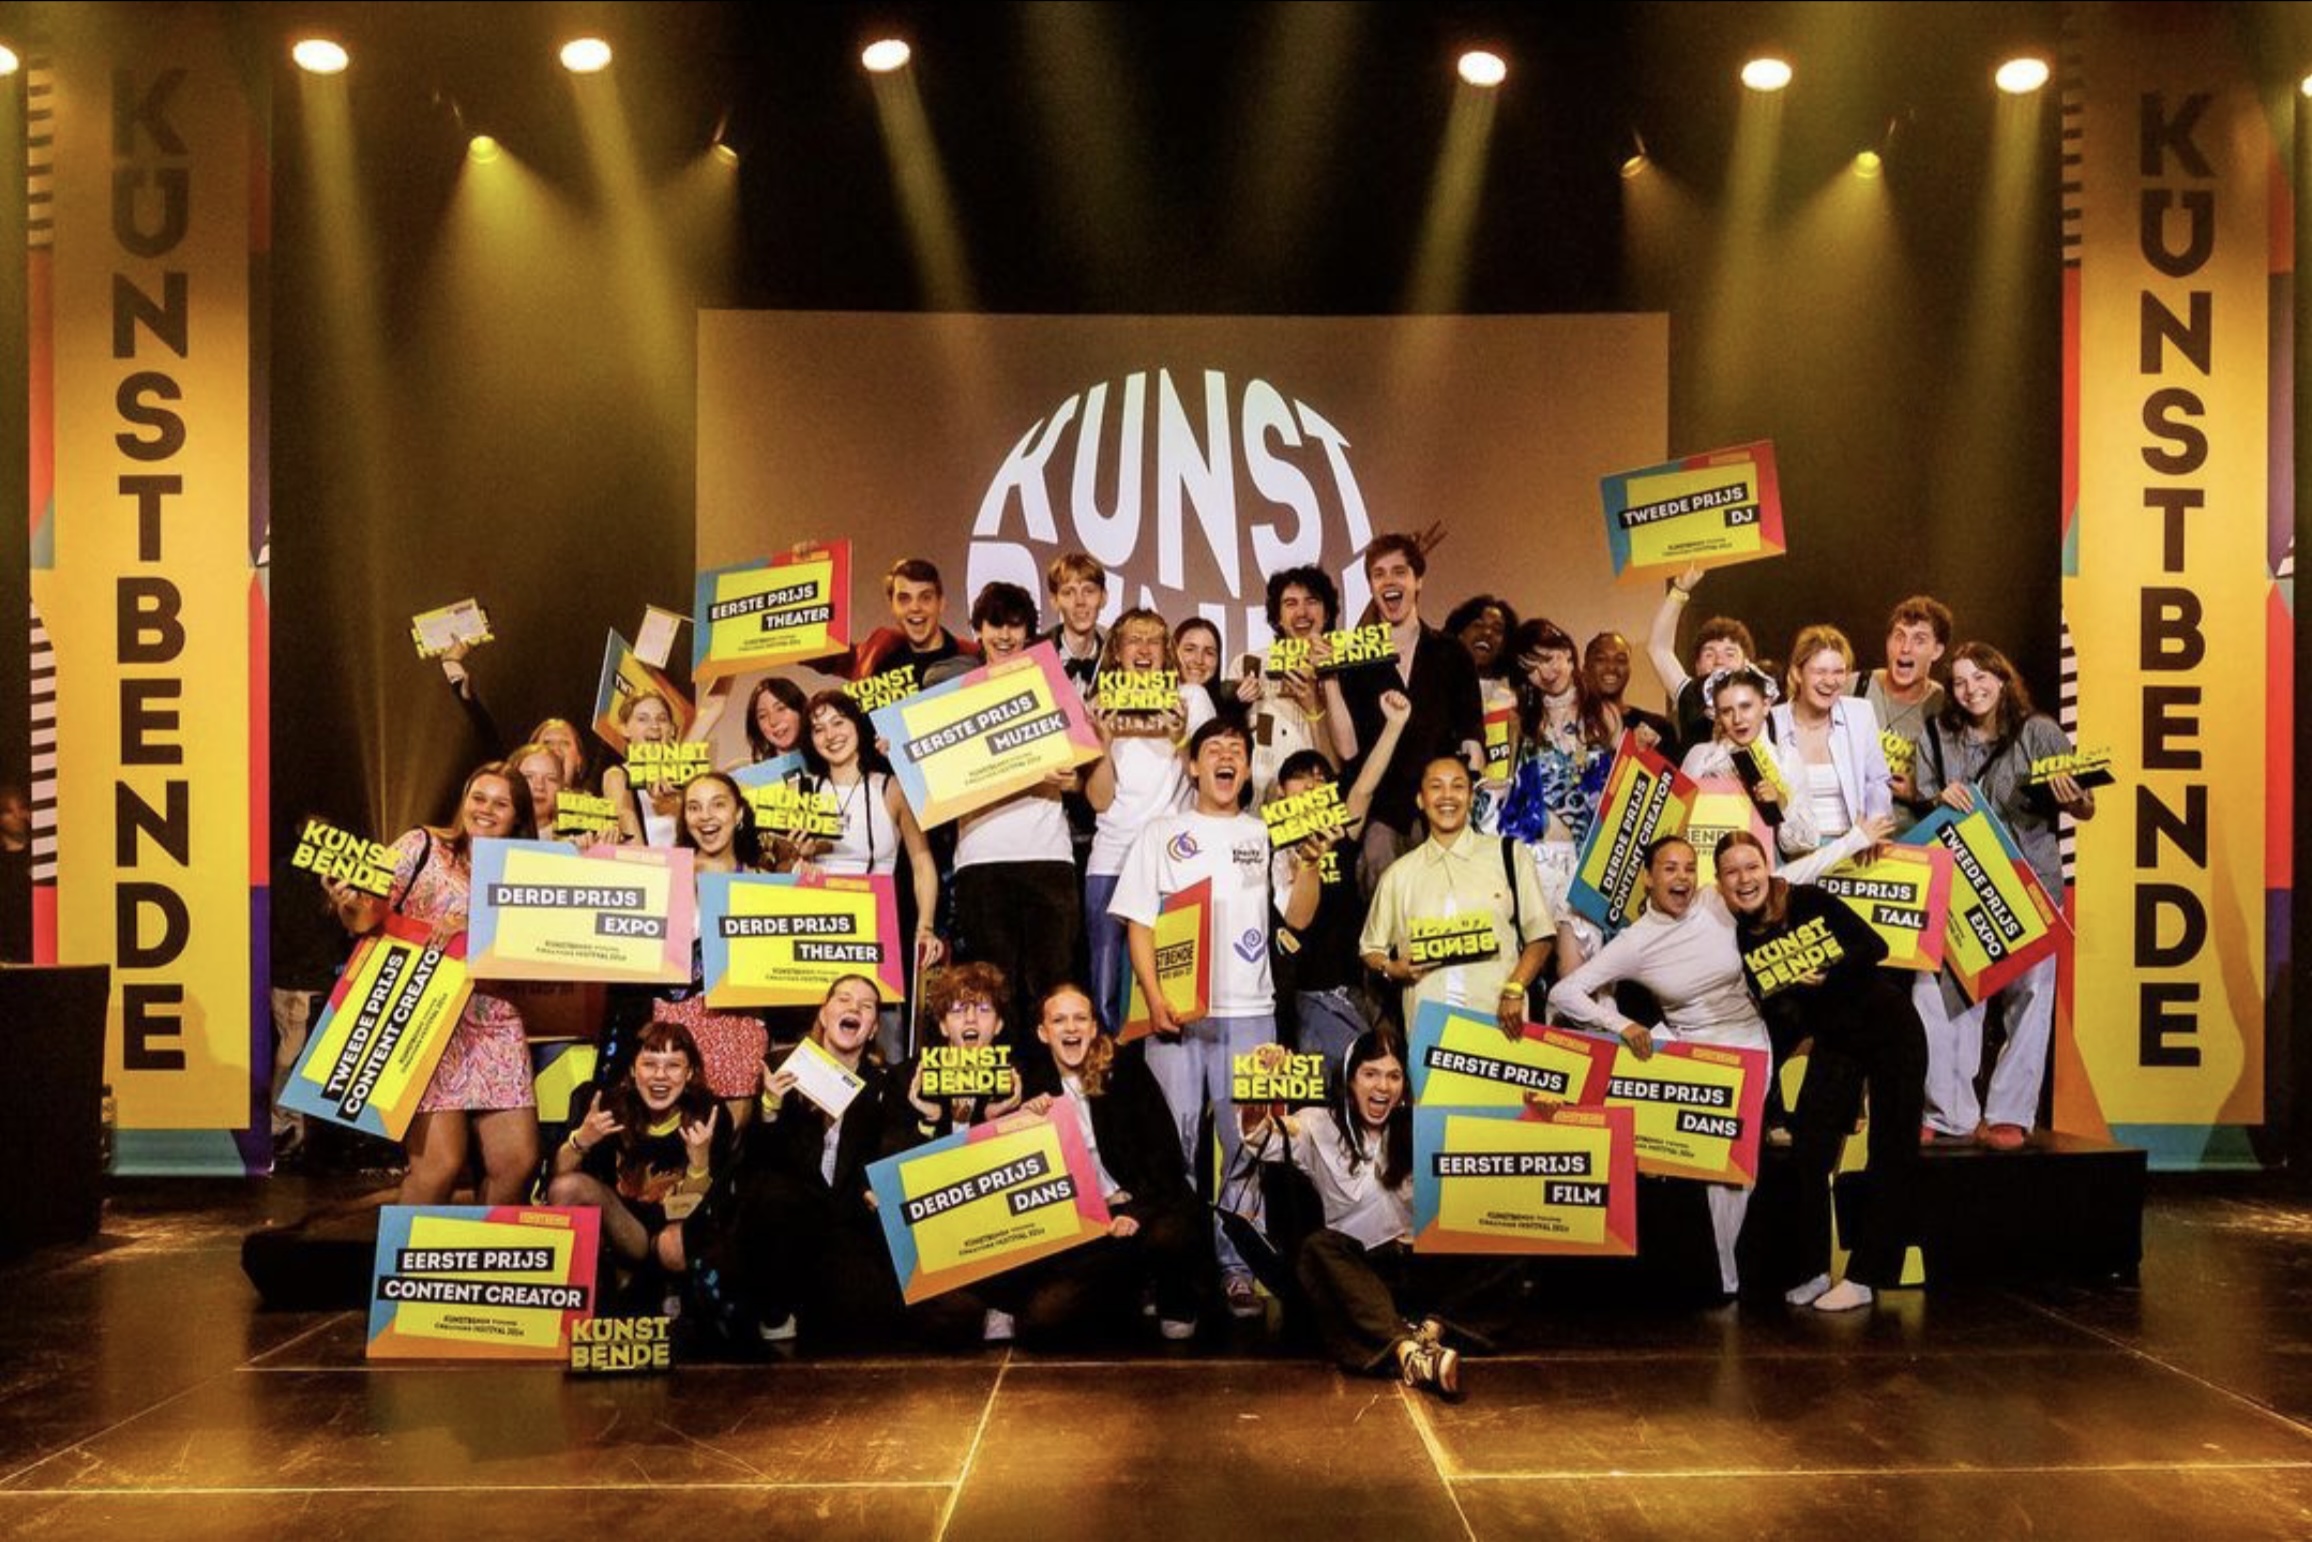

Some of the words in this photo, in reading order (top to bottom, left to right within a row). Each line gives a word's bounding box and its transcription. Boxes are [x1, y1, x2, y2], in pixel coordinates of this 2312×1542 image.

[971, 368, 1373, 598] KUNST
[1623, 499, 1690, 526] TWEEDE
[1692, 486, 1744, 510] PRIJS
[1731, 507, 1753, 525] DJ
[111, 68, 191, 1070] KUNSTBENDE
[2134, 92, 2216, 1067] KUNSTBENDE
[711, 596, 766, 620] EERSTE
[767, 584, 815, 607] PRIJS
[766, 606, 830, 631] THEATER
[842, 664, 915, 699] KUNST
[1098, 668, 1179, 690] KUNST
[860, 683, 919, 713] ENDE
[909, 719, 977, 759] EERSTE
[977, 696, 1034, 728] PRIJS
[993, 715, 1064, 751] MUZIEK
[628, 742, 708, 762] KUNST
[1260, 781, 1339, 824] KUNST
[1602, 833, 1630, 892] DERDE
[1622, 779, 1648, 833] PRIJS
[1608, 844, 1645, 922] CONTENT
[1639, 771, 1673, 845] CREATOR
[292, 842, 394, 896] BENDE
[1941, 825, 1988, 888] TWEEDE
[1980, 885, 2020, 937] PRIJS
[497, 887, 568, 906] DERDE
[573, 889, 638, 907] PRIJS
[1854, 883, 1911, 900] PRIJS
[604, 916, 660, 936] EXPO
[724, 918, 788, 936] DERDE
[793, 916, 850, 934] PRIJS
[1878, 908, 1924, 928] TAAL
[1744, 916, 1831, 973] KUNST
[1969, 911, 2003, 956] EXPO
[800, 943, 879, 961] THEATER
[1755, 936, 1845, 992] BENDE
[327, 1013, 375, 1094] TWEEDE
[366, 954, 404, 1015] PRIJS
[344, 1024, 400, 1115] CONTENT
[393, 941, 441, 1024] CREATO
[921, 1045, 1012, 1067] KUNST
[1430, 1050, 1501, 1080] EERSTE
[1502, 1064, 1563, 1091] PRIJS
[921, 1069, 1012, 1095] BENDE
[1232, 1076, 1325, 1100] BENDE
[1664, 1084, 1725, 1105] PRIJS
[1683, 1115, 1738, 1137] DANS
[1438, 1156, 1515, 1174] EERSTE
[1520, 1155, 1586, 1173] PRIJS
[909, 1182, 976, 1220] DERDE
[977, 1158, 1041, 1195] PRIJS
[1013, 1180, 1072, 1211] DANS
[1552, 1186, 1601, 1205] FILM
[402, 1251, 479, 1270] EERSTE
[483, 1250, 549, 1269] PRIJS
[384, 1280, 482, 1301] CONTENT
[485, 1284, 582, 1308] CREATOR
[571, 1317, 672, 1342] KUNST
[571, 1344, 671, 1370] BENDE
